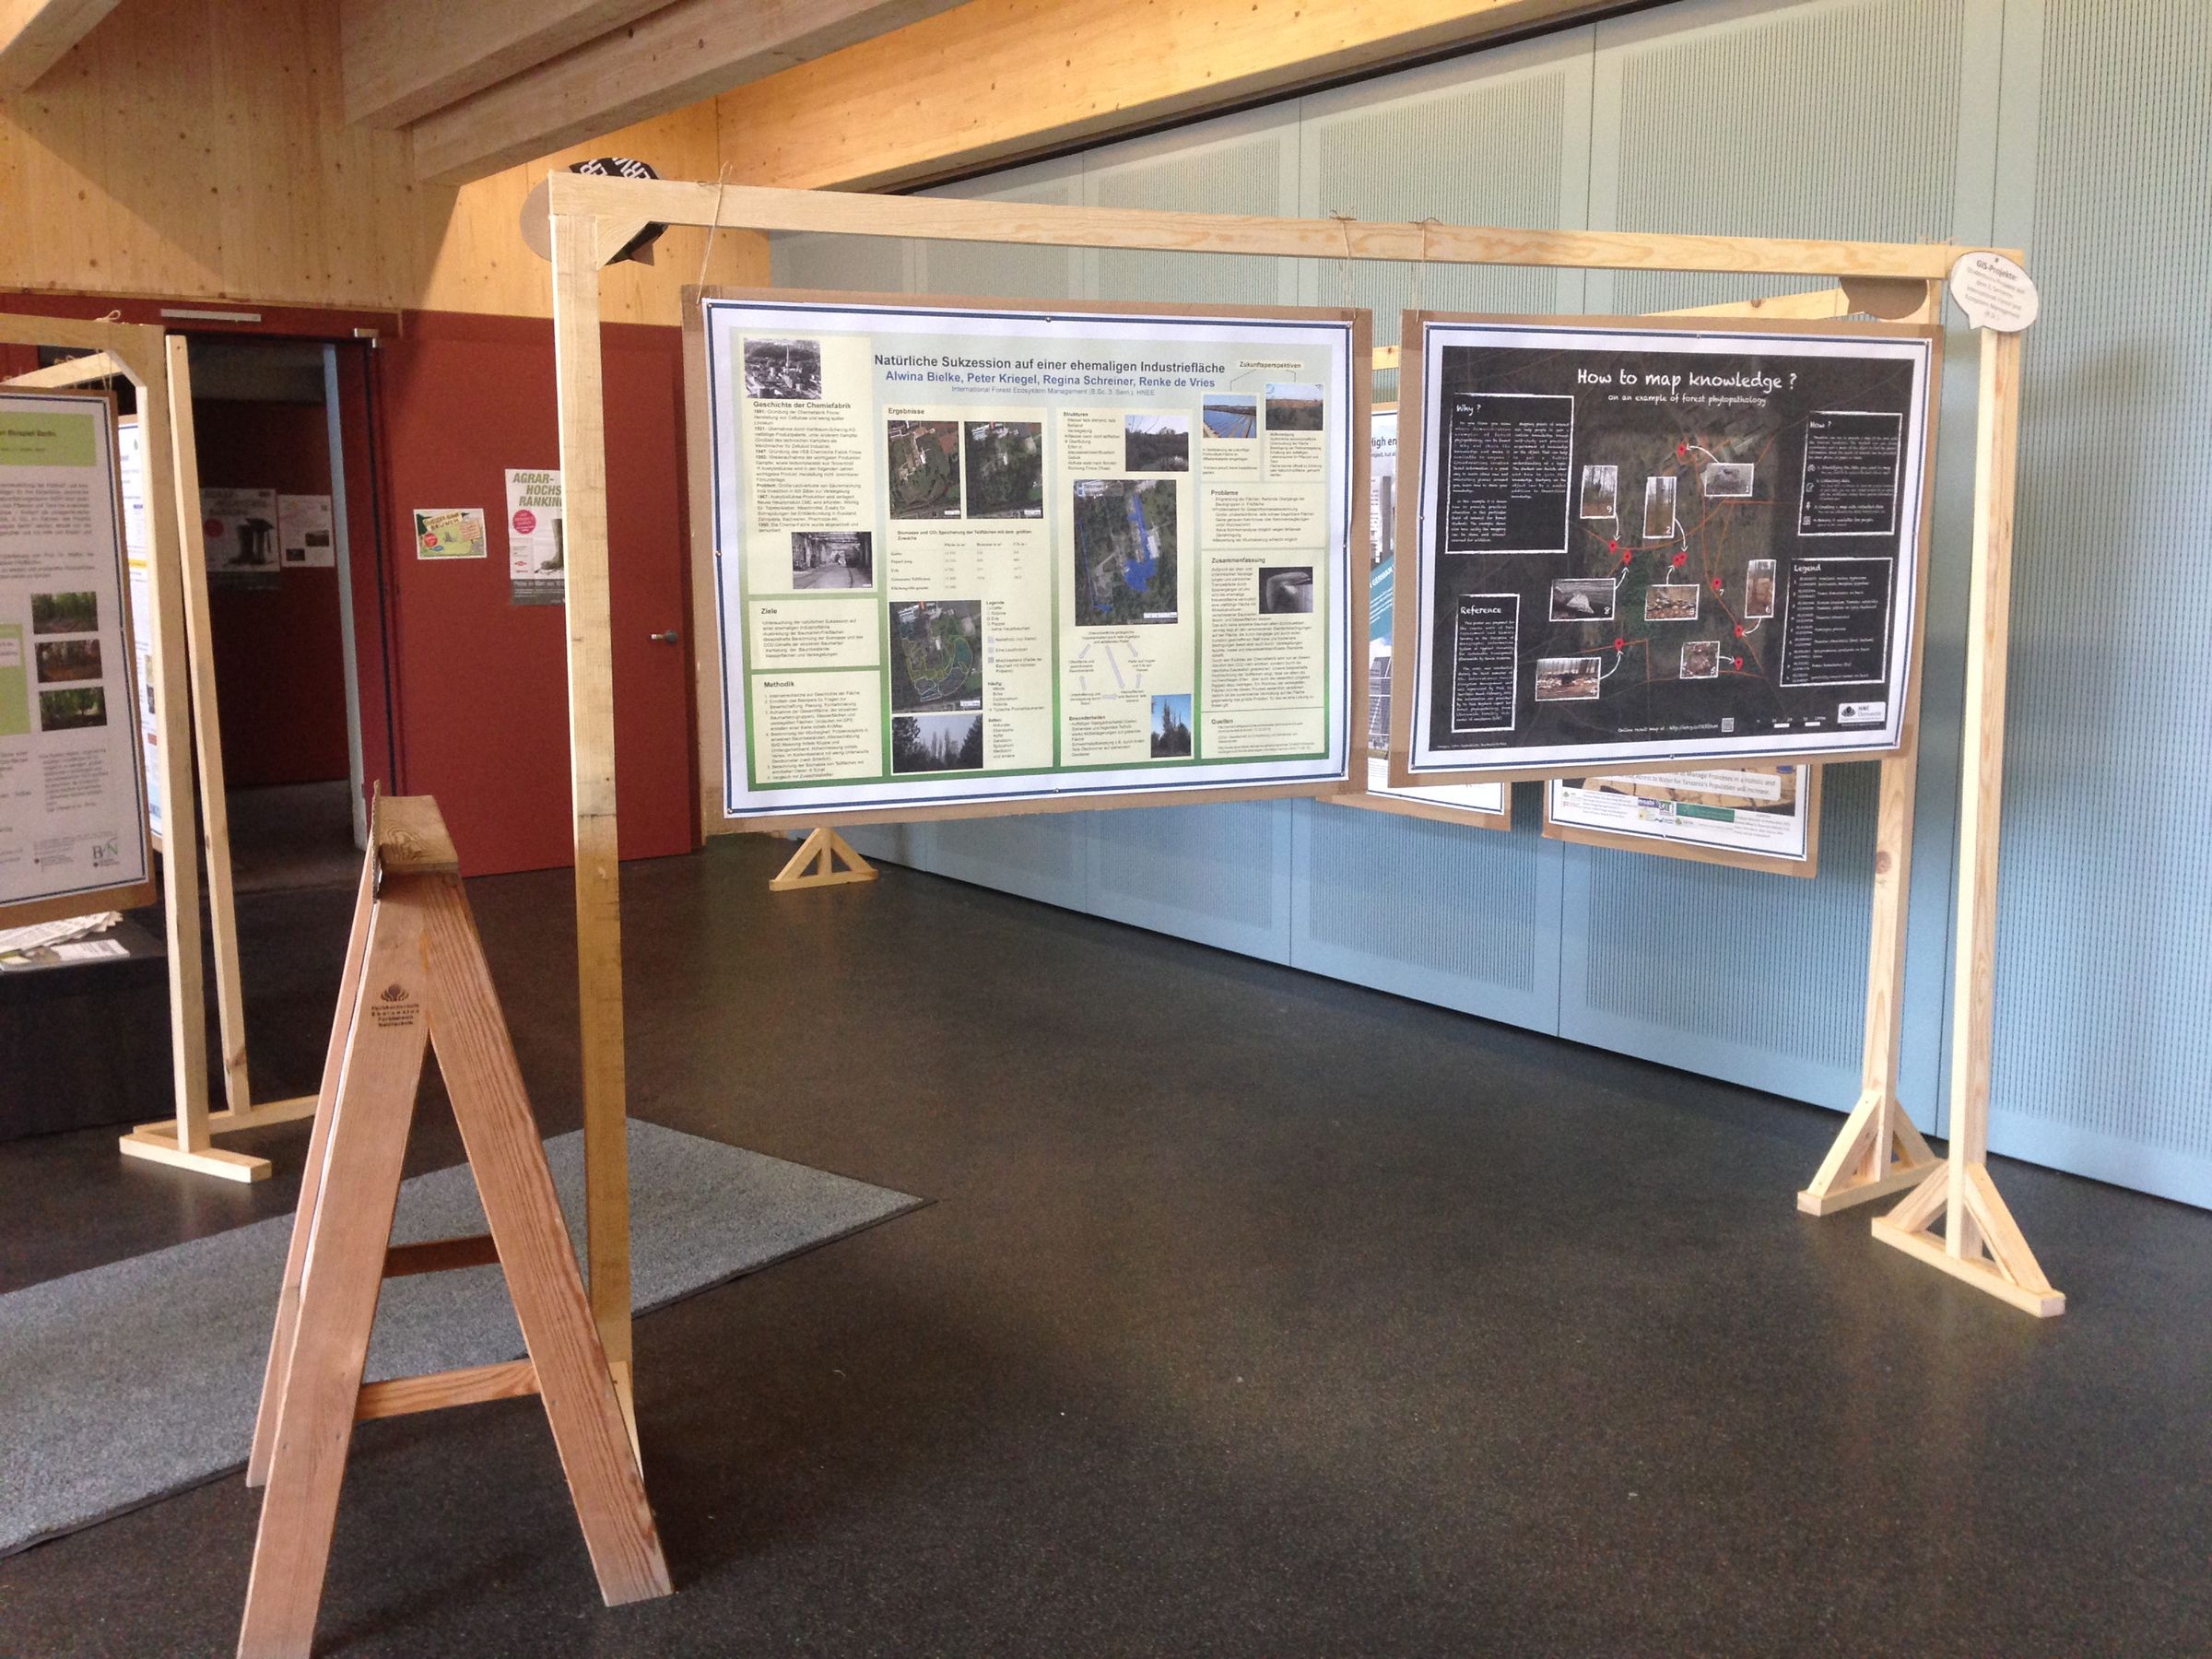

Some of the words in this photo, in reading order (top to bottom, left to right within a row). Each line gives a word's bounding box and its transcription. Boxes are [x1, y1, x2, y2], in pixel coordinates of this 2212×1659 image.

[875, 354, 938, 367] Natürliche
[941, 356, 1012, 370] Sukzession
[1015, 358, 1034, 370] auf
[1037, 359, 1066, 371] einer
[1070, 359, 1137, 374] ehemaligen
[1140, 360, 1226, 374] Industriefläche
[885, 371, 924, 382] Alwina
[927, 371, 965, 384] Bielke,
[967, 372, 996, 383] Peter
[999, 373, 1041, 386] Kriegel,
[1042, 374, 1081, 386] Regina
[1083, 376, 1137, 388] Schreiner,
[1139, 376, 1172, 387] Renke
[1174, 377, 1187, 387] de
[1189, 377, 1216, 388] Vries
[1577, 369, 1613, 385] How
[1619, 368, 1638, 386] to
[1645, 371, 1682, 395] map
[1688, 371, 1783, 394] knowledge
[1788, 372, 1798, 391] ?
[951, 385, 991, 394] International
[1635, 394, 1668, 406] example
[1669, 394, 1680, 404] of
[1681, 394, 1706, 404] forest
[1708, 394, 1767, 407] phytopathology
[888, 407, 925, 416] Ergebnisse
[1456, 404, 1474, 417] Why
[1477, 404, 1482, 413] ?
[1809, 420, 1825, 429] How
[512, 472, 555, 484] AGRAR-
[519, 496, 562, 507] RANKIN
[1606, 505, 1613, 513] 9
[1665, 526, 1672, 535] 2
[1794, 563, 1822, 574] Legend
[1719, 589, 1725, 597] 7
[1460, 604, 1502, 616] Reference
[1604, 606, 1611, 615] 8
[1765, 605, 1771, 614] 6
